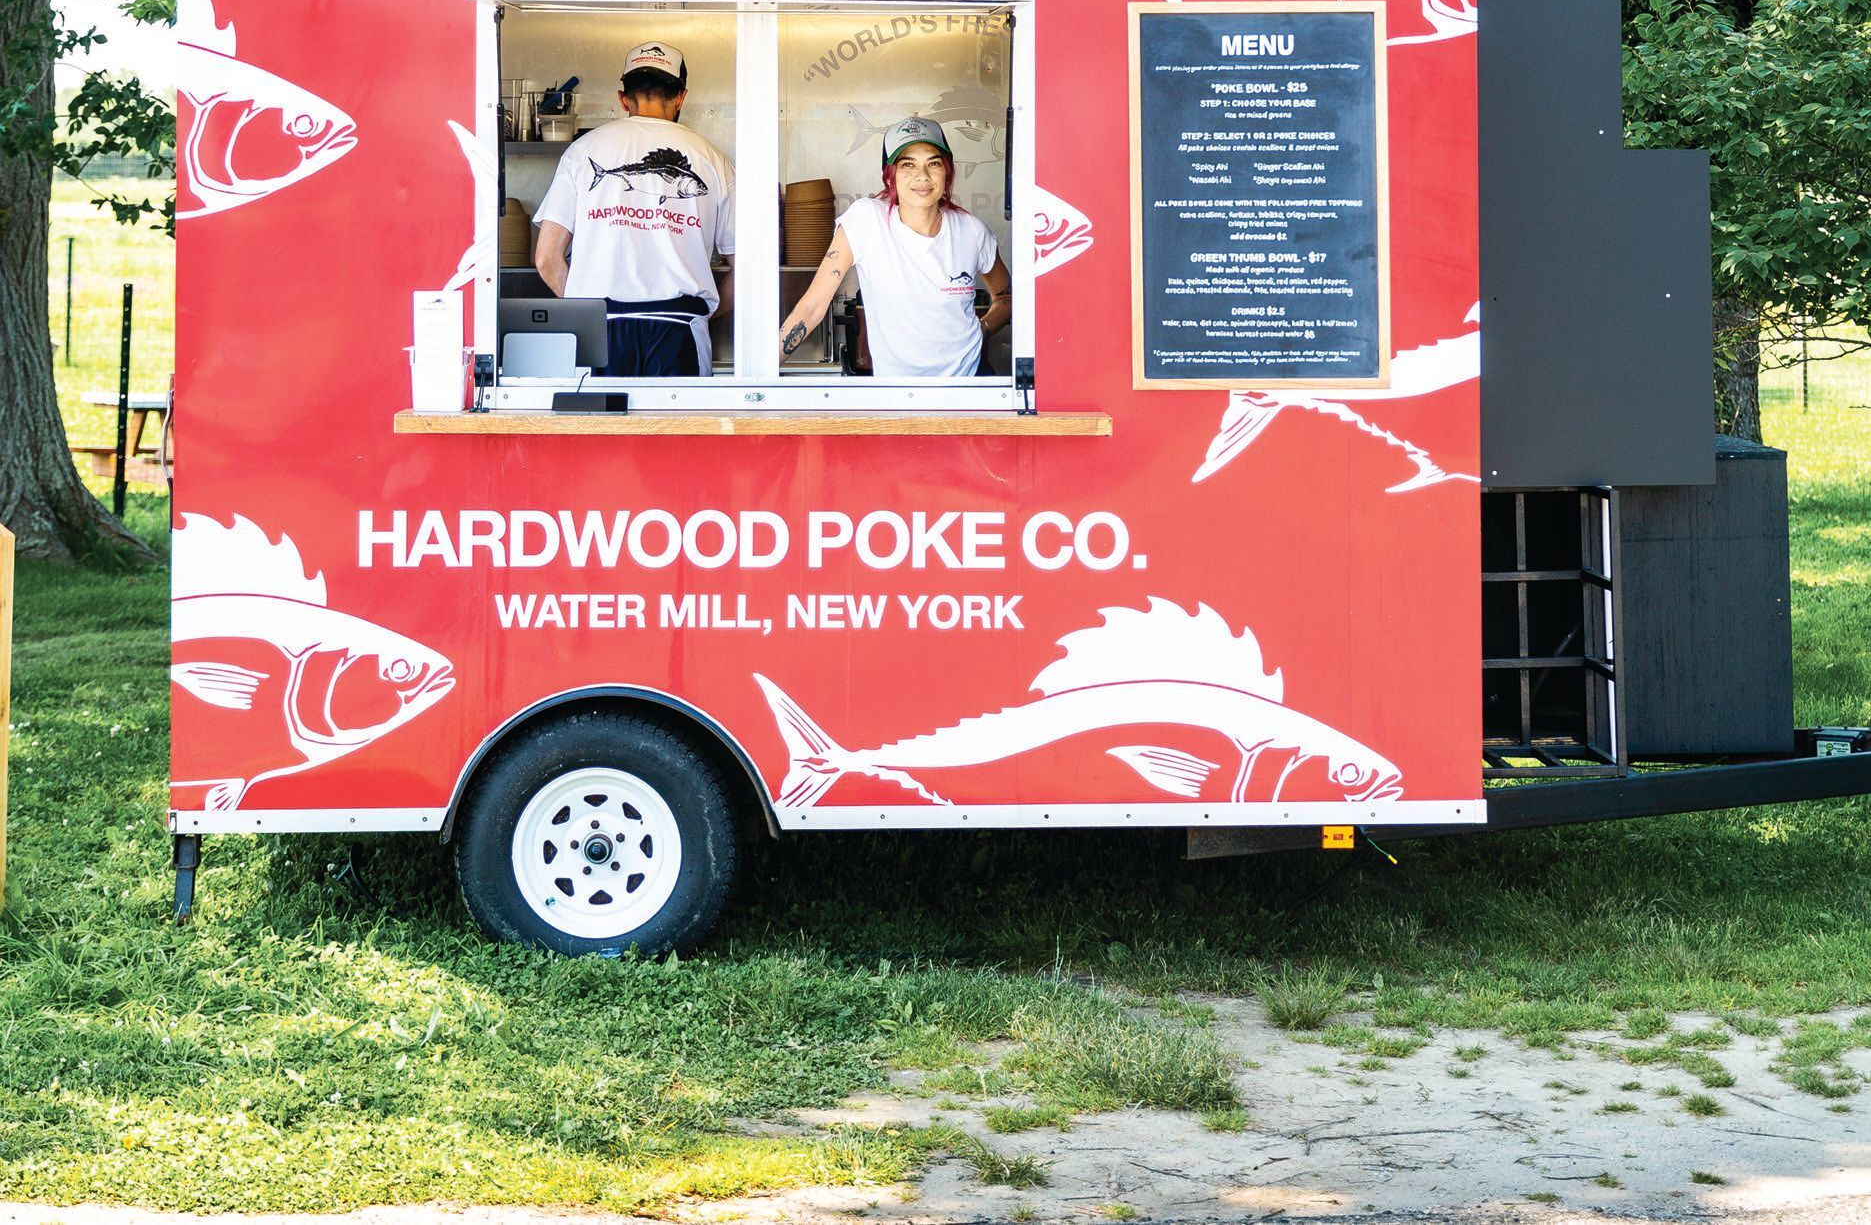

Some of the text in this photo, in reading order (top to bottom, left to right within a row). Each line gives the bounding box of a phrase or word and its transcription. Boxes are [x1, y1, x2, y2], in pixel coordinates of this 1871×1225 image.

[1221, 35, 1294, 56] MENU
[1246, 84, 1278, 93] BOWL
[1287, 82, 1308, 93] $25
[1232, 99, 1267, 107] CHOOSE
[1268, 99, 1292, 107] YOUR
[1293, 99, 1316, 107] BASE
[1181, 132, 1203, 140] STEP
[1203, 132, 1211, 140] 2:
[1213, 132, 1245, 140] SELECT
[1298, 132, 1336, 140] CHOICES
[1313, 176, 1326, 184] Ahi
[588, 206, 653, 220] HARDWOOD
[655, 209, 685, 225] POKE
[609, 219, 630, 227] ATER
[1276, 232, 1288, 241] $2
[1190, 253, 1227, 262] GREEN
[1228, 253, 1266, 262] THUMB
[1268, 253, 1301, 262] BOWL
[1308, 251, 1327, 263] $17
[1231, 306, 1285, 316] DRINKS $2.5
[358, 510, 1147, 571] HARDWOOD POKE CO.
[494, 594, 1025, 635] WATER MILL, NEW YORK
